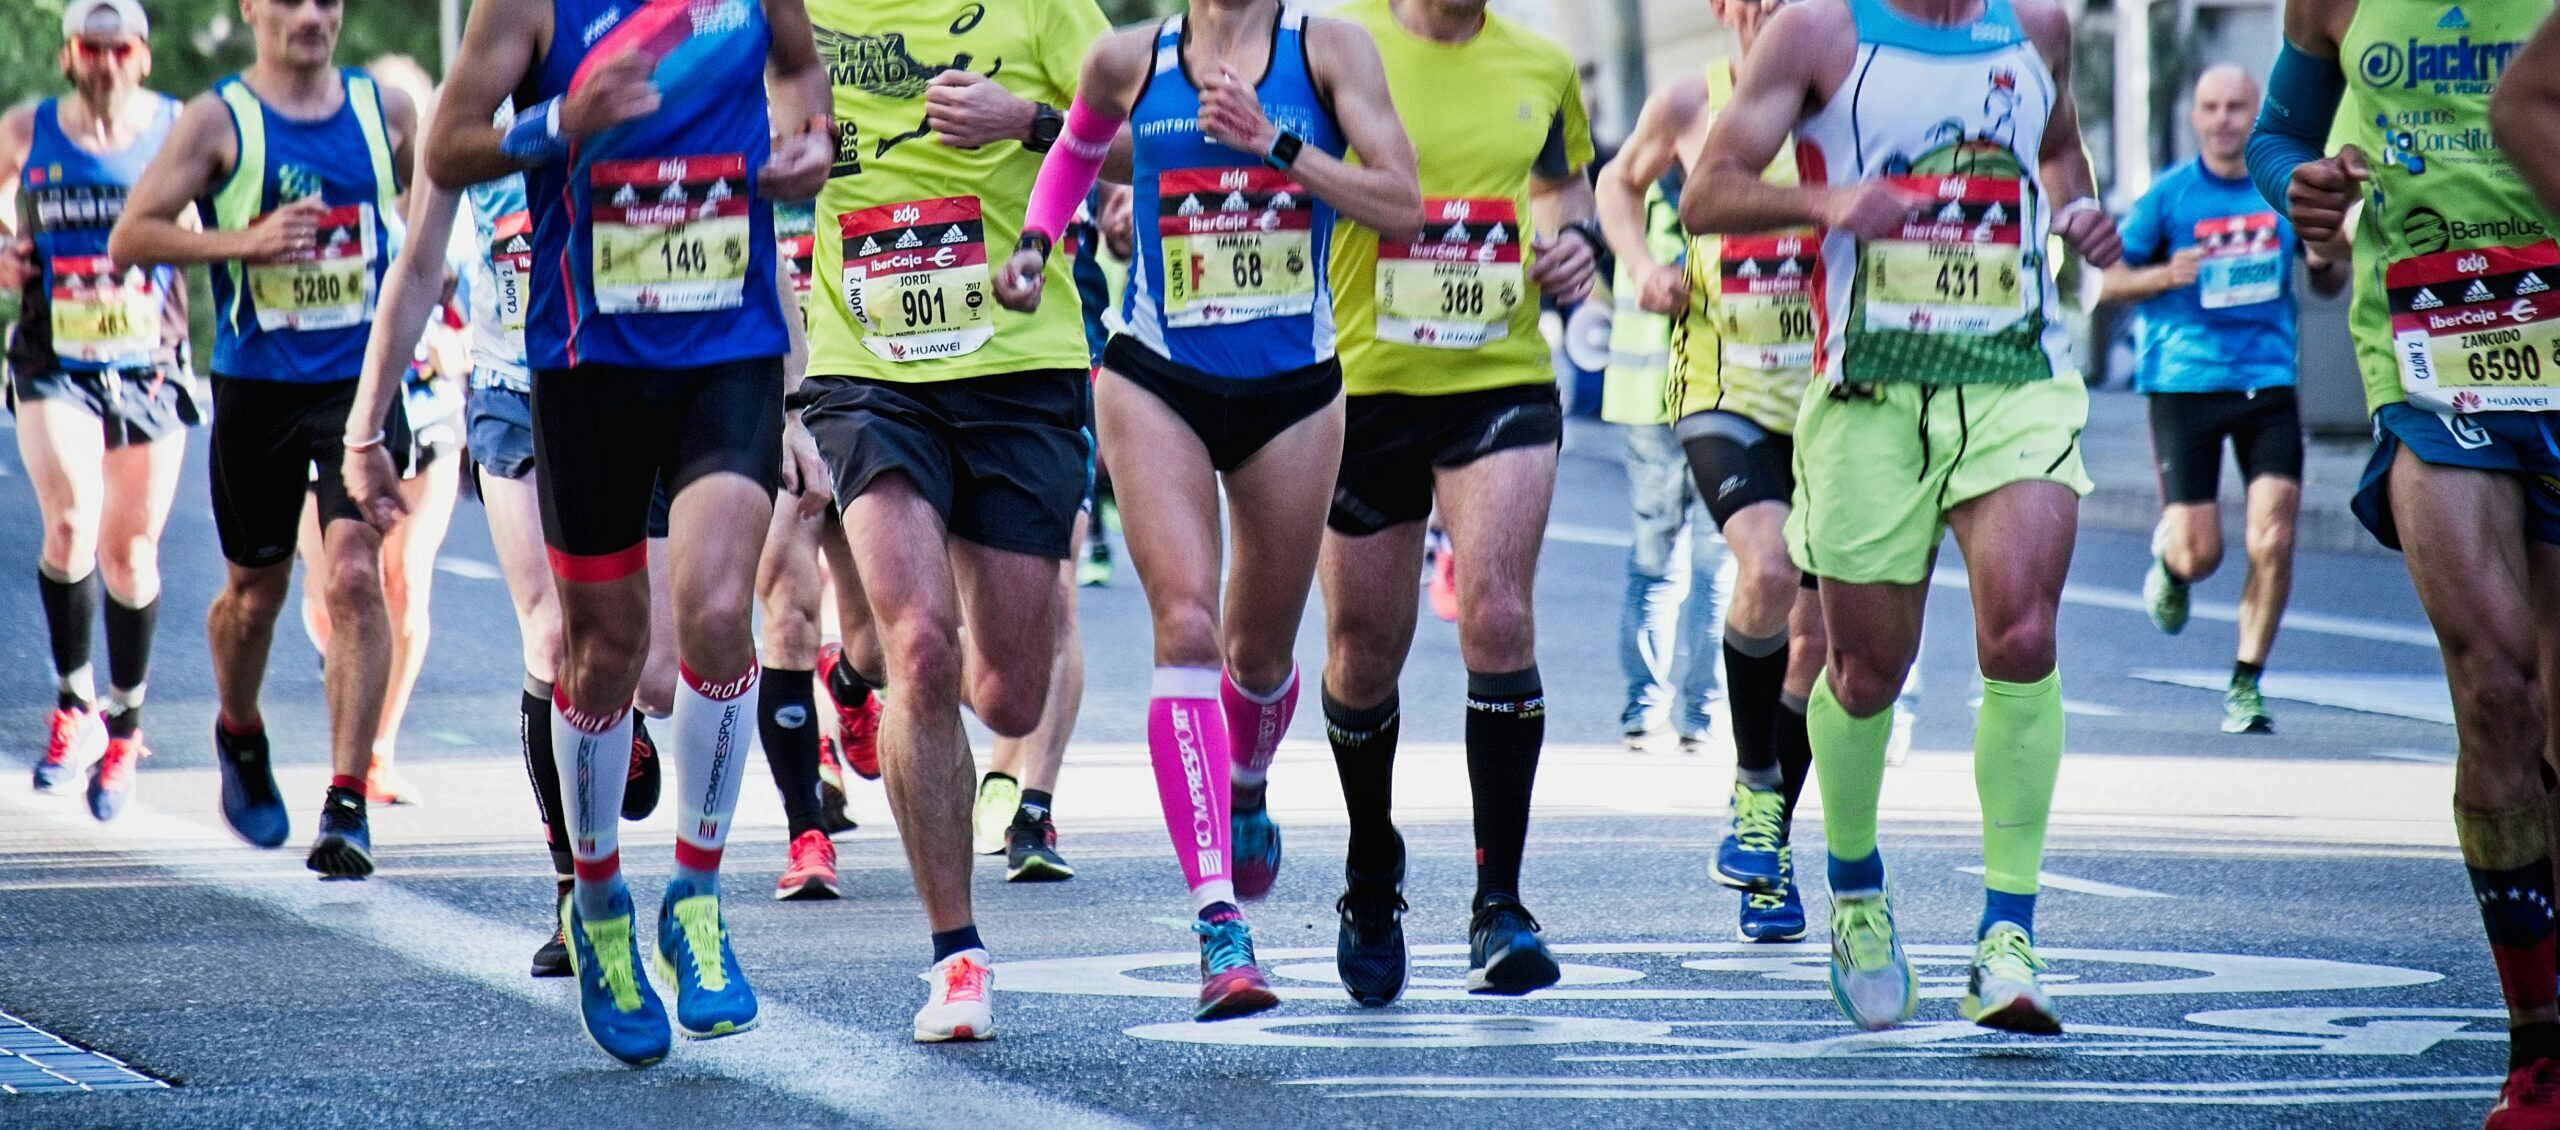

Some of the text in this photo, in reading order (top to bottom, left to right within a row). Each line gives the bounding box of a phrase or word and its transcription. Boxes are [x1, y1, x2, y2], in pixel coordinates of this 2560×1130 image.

[828, 61, 908, 86] MAD
[893, 205, 920, 225] edp
[2451, 216, 2545, 241] Banplus
[871, 254, 922, 272] iberCaja
[1190, 253, 1205, 293] F
[1232, 252, 1263, 289] 68
[2456, 252, 2489, 275] edp
[293, 273, 340, 305] 5280
[900, 274, 931, 287] JORDI
[1936, 262, 1979, 298] 431
[2516, 284, 2550, 296] adidas
[850, 276, 868, 324] CAJÓN 2
[902, 287, 946, 327] 901
[1441, 281, 1484, 315] 388
[2411, 300, 2444, 311] adidas
[2463, 292, 2496, 303] adidas
[2429, 309, 2497, 329] iberCaja
[910, 341, 961, 356] HUAWEI
[2461, 329, 2521, 349] ZANCUDO
[2408, 341, 2430, 380] CAJÓN 2
[2468, 345, 2541, 381] 6590
[2487, 397, 2549, 406] HUAWEI
[703, 704, 736, 817] COMPRESSPORT
